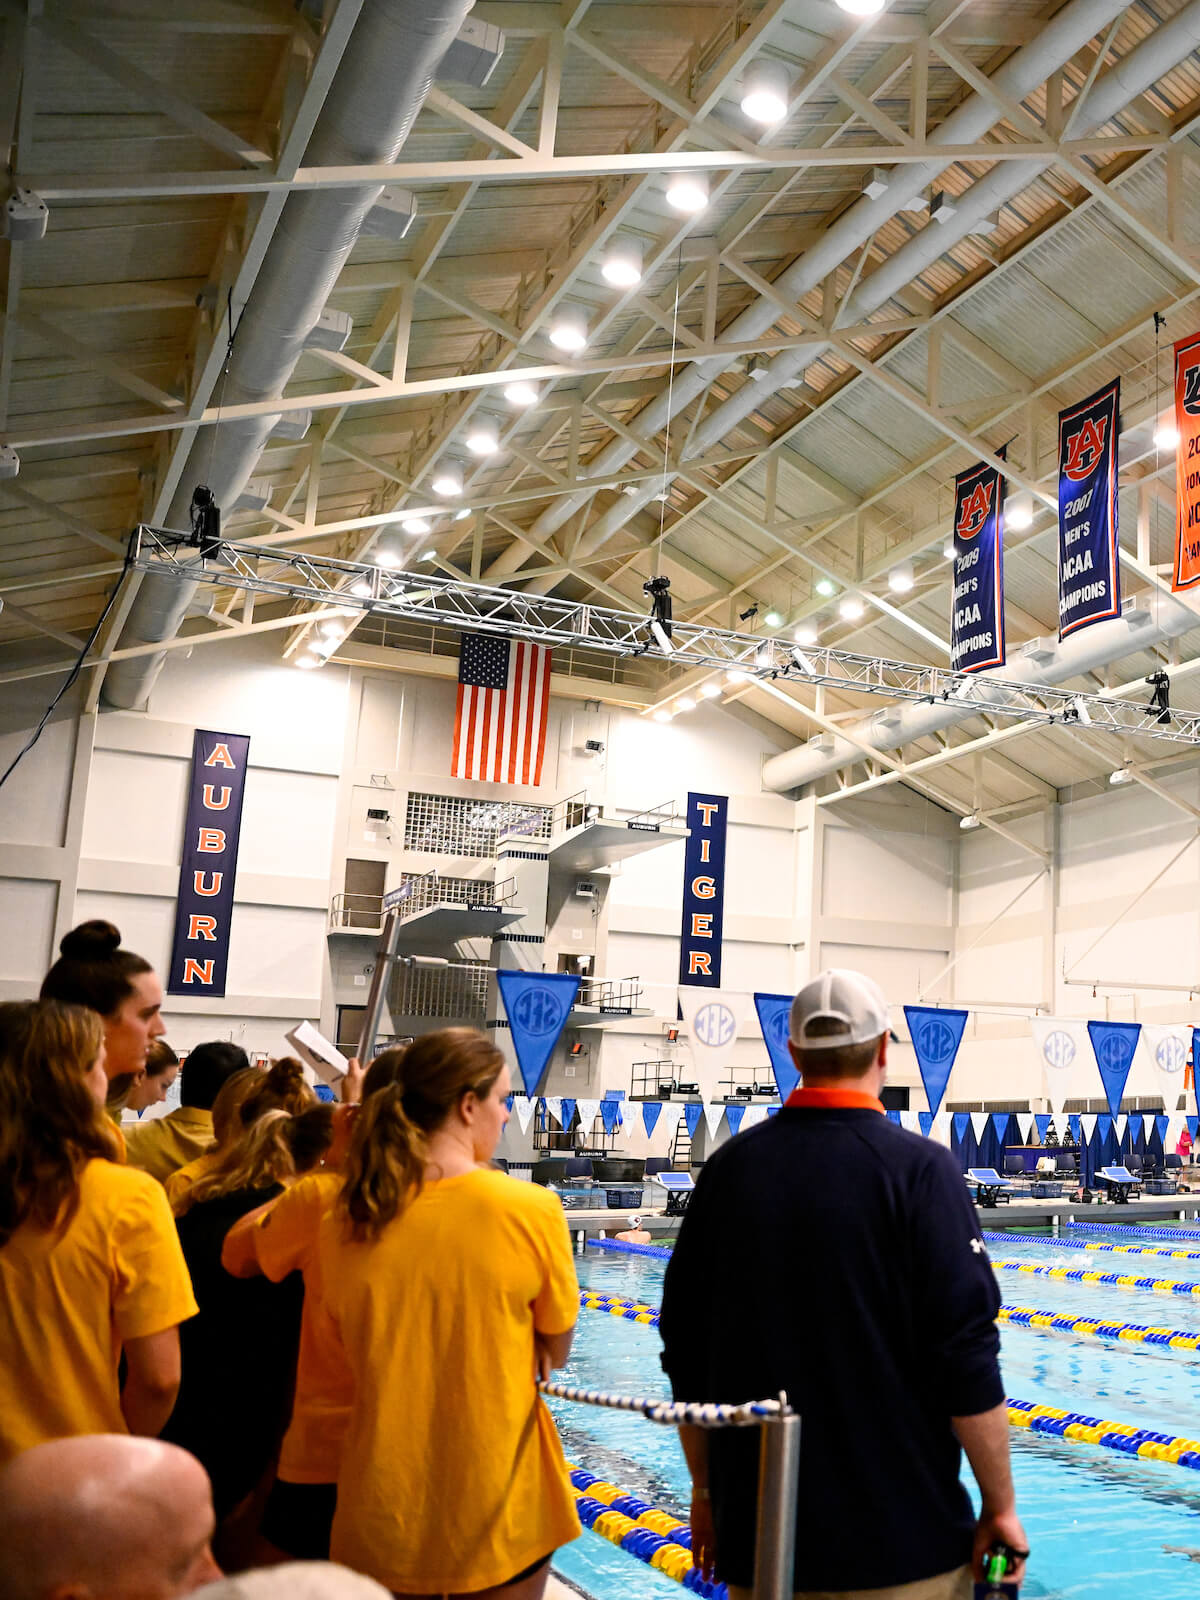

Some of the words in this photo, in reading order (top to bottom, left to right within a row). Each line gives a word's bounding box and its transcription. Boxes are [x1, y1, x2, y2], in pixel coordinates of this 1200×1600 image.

[1064, 489, 1093, 520] 2007
[957, 547, 979, 574] 2009
[1063, 550, 1093, 582] NCAA
[1060, 580, 1106, 615] CAMPIONS
[183, 743, 236, 985] AUBURN
